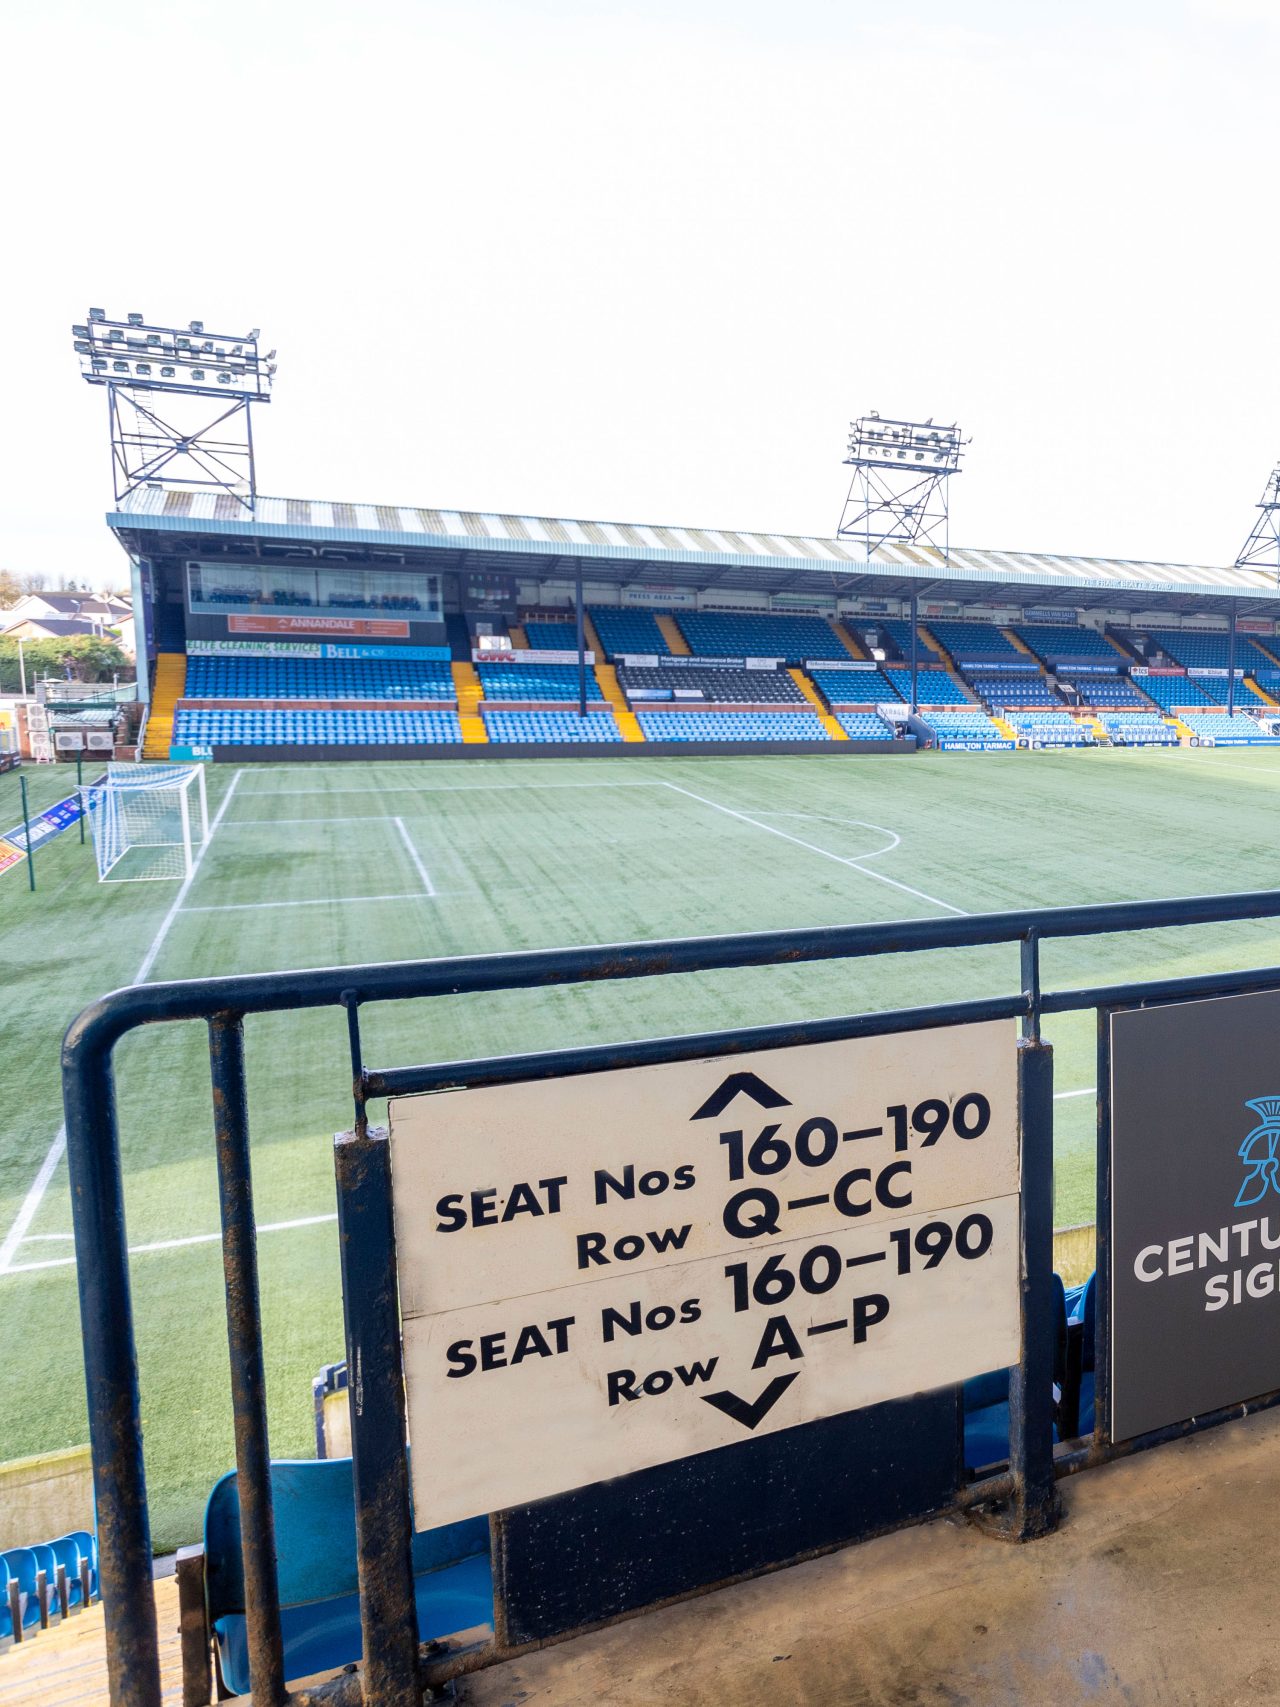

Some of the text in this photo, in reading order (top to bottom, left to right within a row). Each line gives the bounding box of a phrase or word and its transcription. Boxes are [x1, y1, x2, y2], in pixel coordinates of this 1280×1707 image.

[290, 618, 356, 630] ANNANDALE
[187, 640, 320, 652] ELITE CLEANING SERVICES
[326, 644, 361, 659] BELL
[944, 742, 1013, 750] HAMILTON TARMAC
[435, 1176, 567, 1233] SEAT
[594, 1164, 696, 1205] Nos
[577, 1224, 693, 1270] Row
[446, 1317, 576, 1379] SEAT
[602, 1298, 701, 1343] Nos
[607, 1356, 720, 1407] Row
